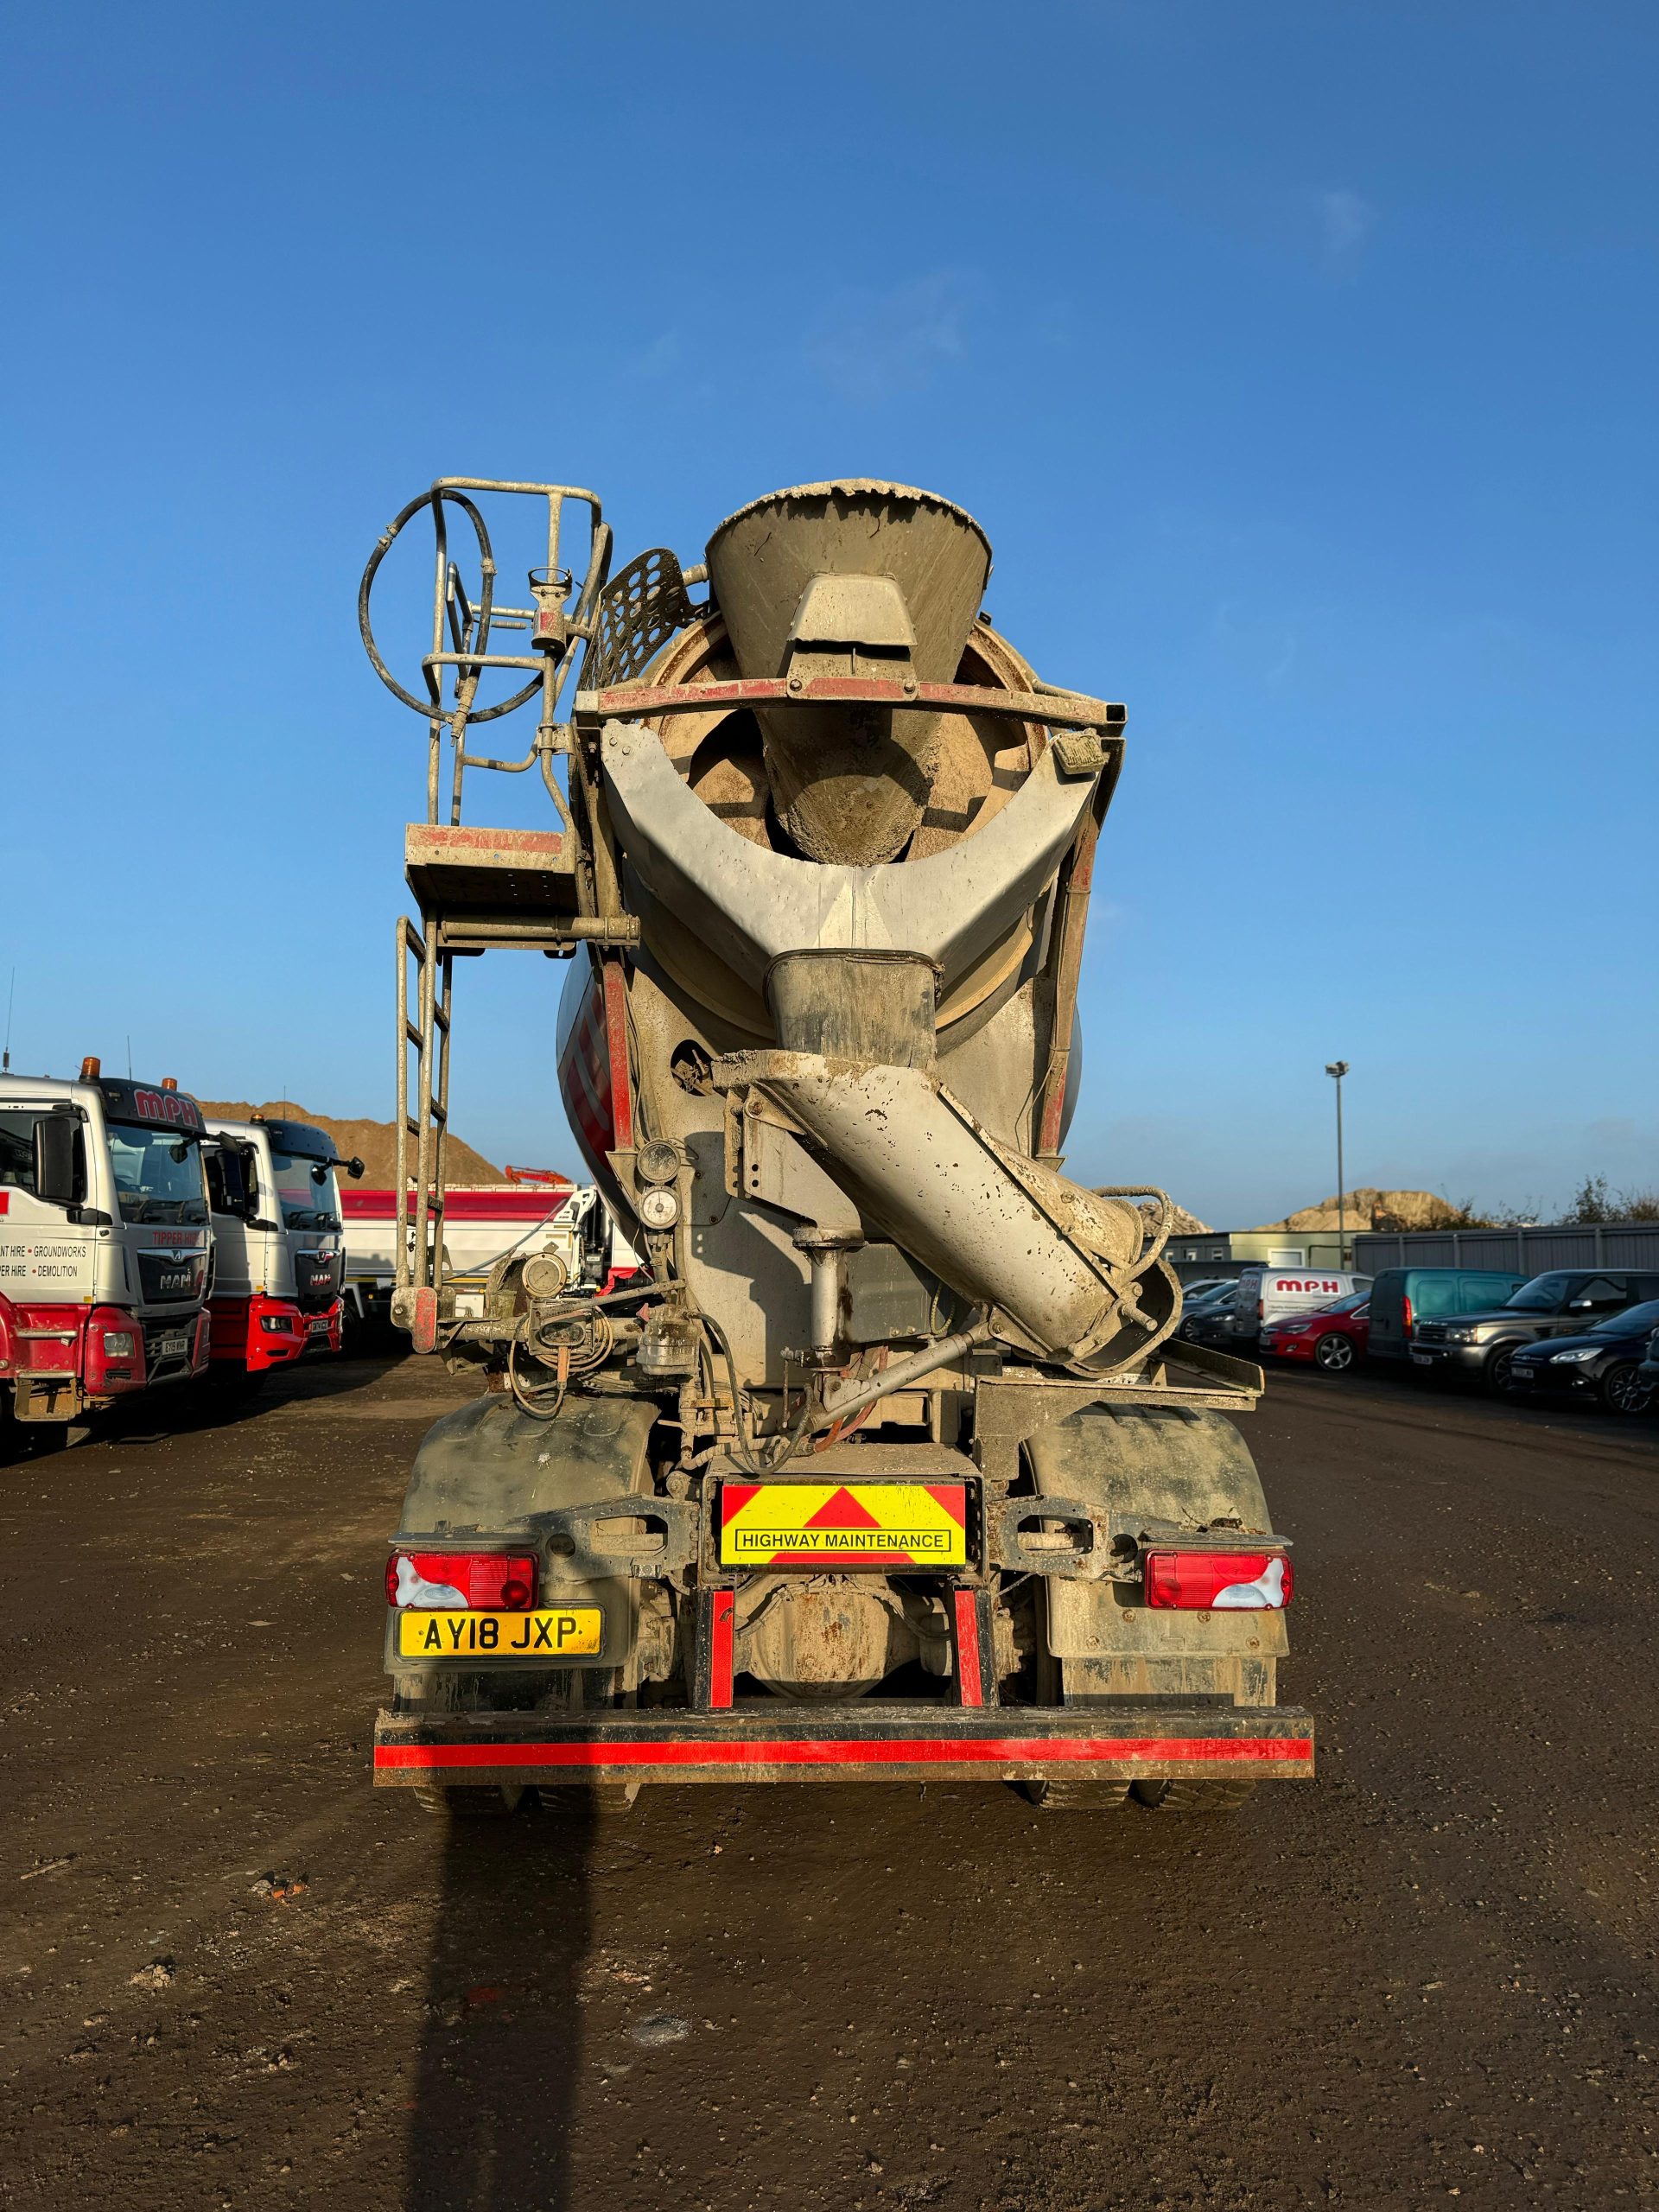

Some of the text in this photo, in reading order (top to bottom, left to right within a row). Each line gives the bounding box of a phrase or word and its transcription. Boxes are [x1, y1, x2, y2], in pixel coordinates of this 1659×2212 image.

[134, 1089, 199, 1128] MPH
[152, 1230, 182, 1245] TIPPER
[0, 1245, 25, 1257] NT HIRE
[34, 1245, 86, 1257] GROUNDWORKS
[11, 1265, 26, 1277] HIRE
[37, 1265, 78, 1277] DEMOLITION
[160, 1274, 192, 1290] MAN
[310, 1274, 332, 1286] MAN
[1276, 1280, 1338, 1293] MPH
[742, 1534, 944, 1548] HIGHWAY MAINTENANCE
[423, 1617, 577, 1649] AY18 JXP
